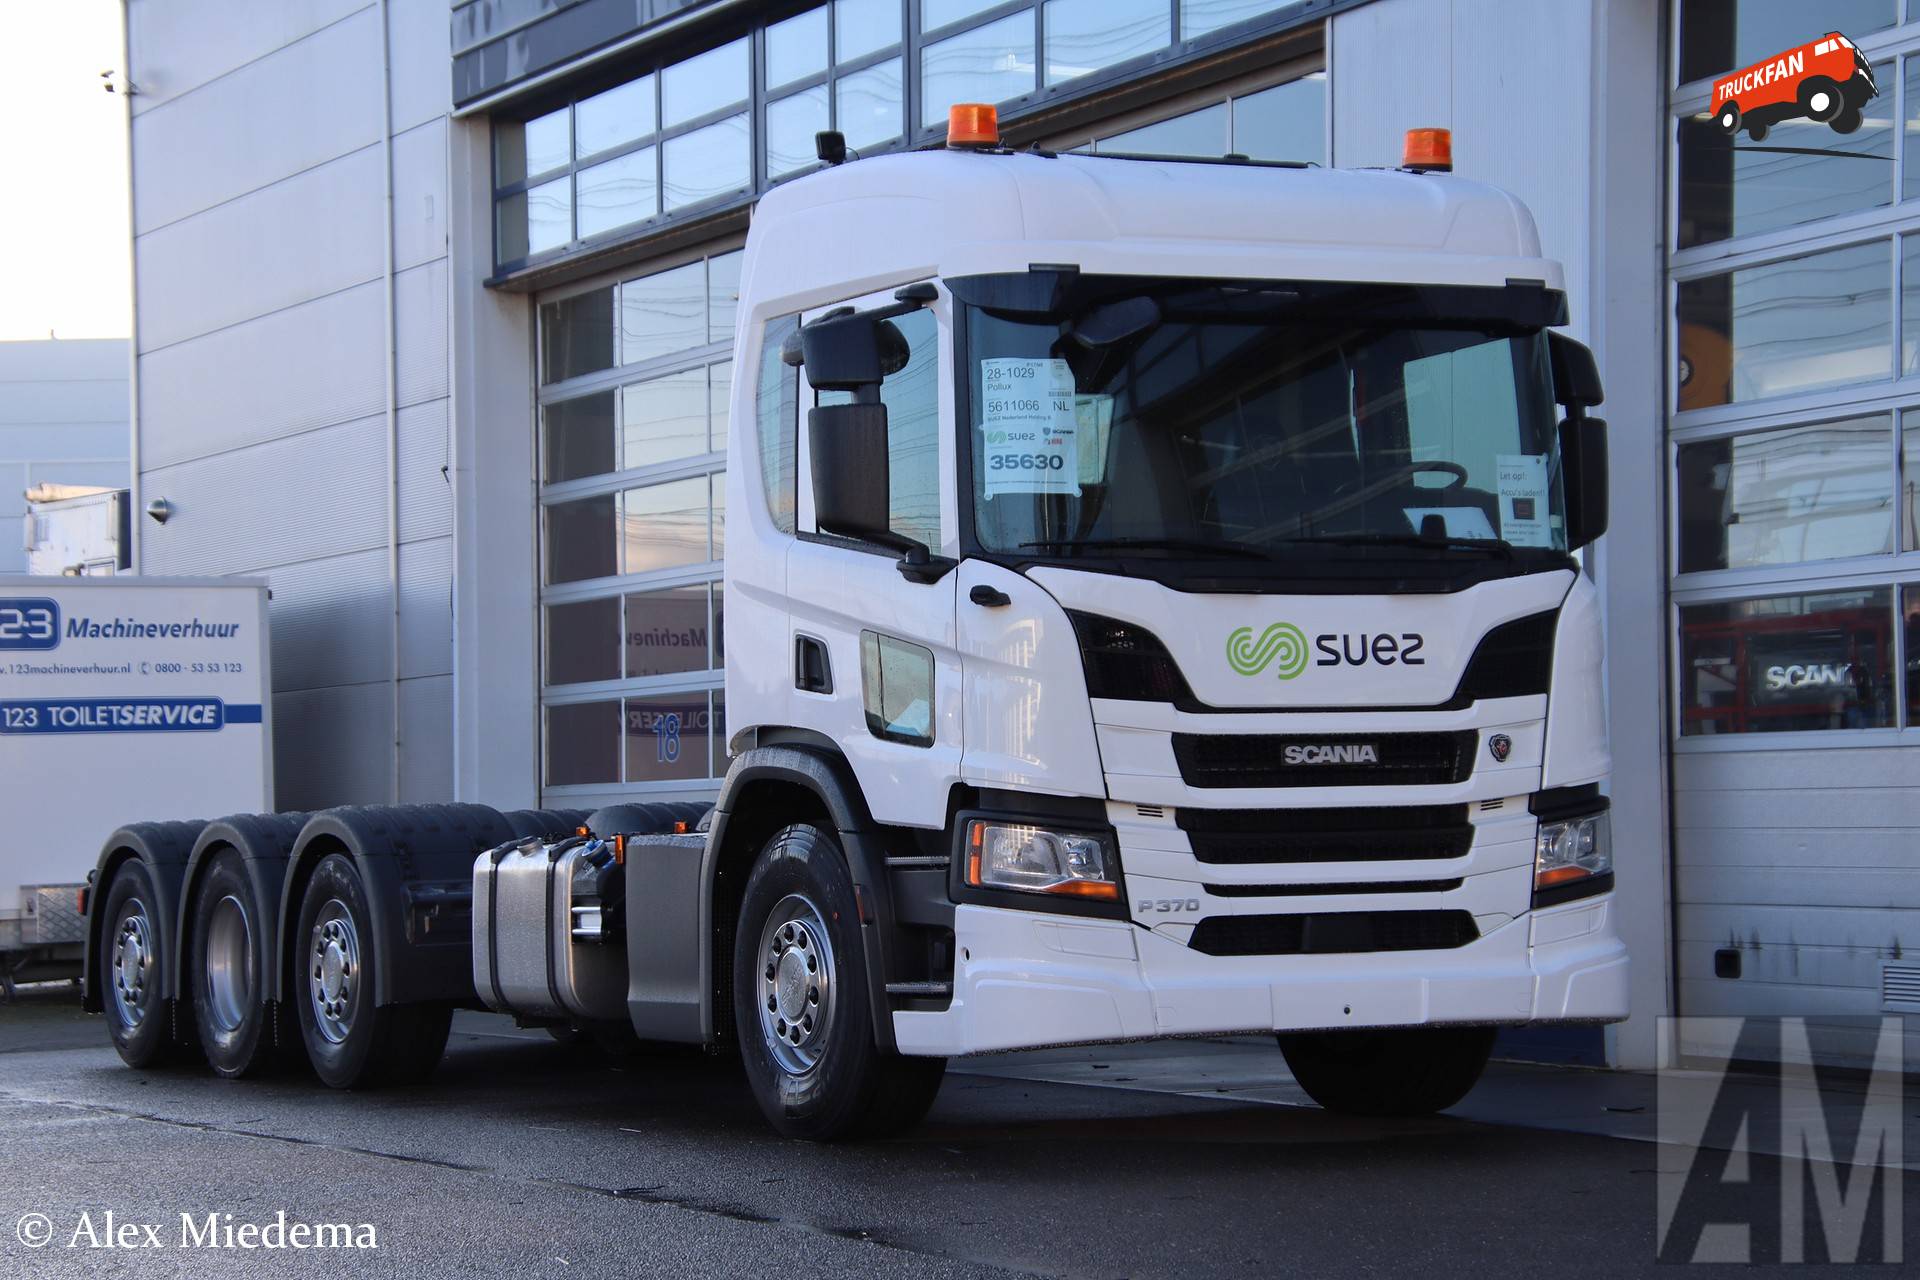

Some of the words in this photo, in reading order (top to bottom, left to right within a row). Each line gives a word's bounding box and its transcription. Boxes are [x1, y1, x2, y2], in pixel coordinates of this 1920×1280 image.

[987, 367, 1035, 380] 28-1029
[988, 400, 1040, 413] 5611066
[1053, 401, 1070, 412] NL
[1007, 431, 1037, 441] suez
[990, 454, 1064, 470] 35630
[66, 617, 240, 639] Machineverhuur
[1316, 632, 1426, 666] suez
[155, 662, 182, 674] 0800
[191, 662, 205, 674] 53
[206, 662, 220, 674] 53
[224, 662, 243, 674] 123
[3, 706, 39, 728] 123
[48, 704, 217, 727] TOILETSERVICE
[652, 712, 682, 764] 18
[1284, 744, 1379, 765] SCANIA
[1138, 899, 1154, 913] P
[1156, 898, 1200, 913] 370
